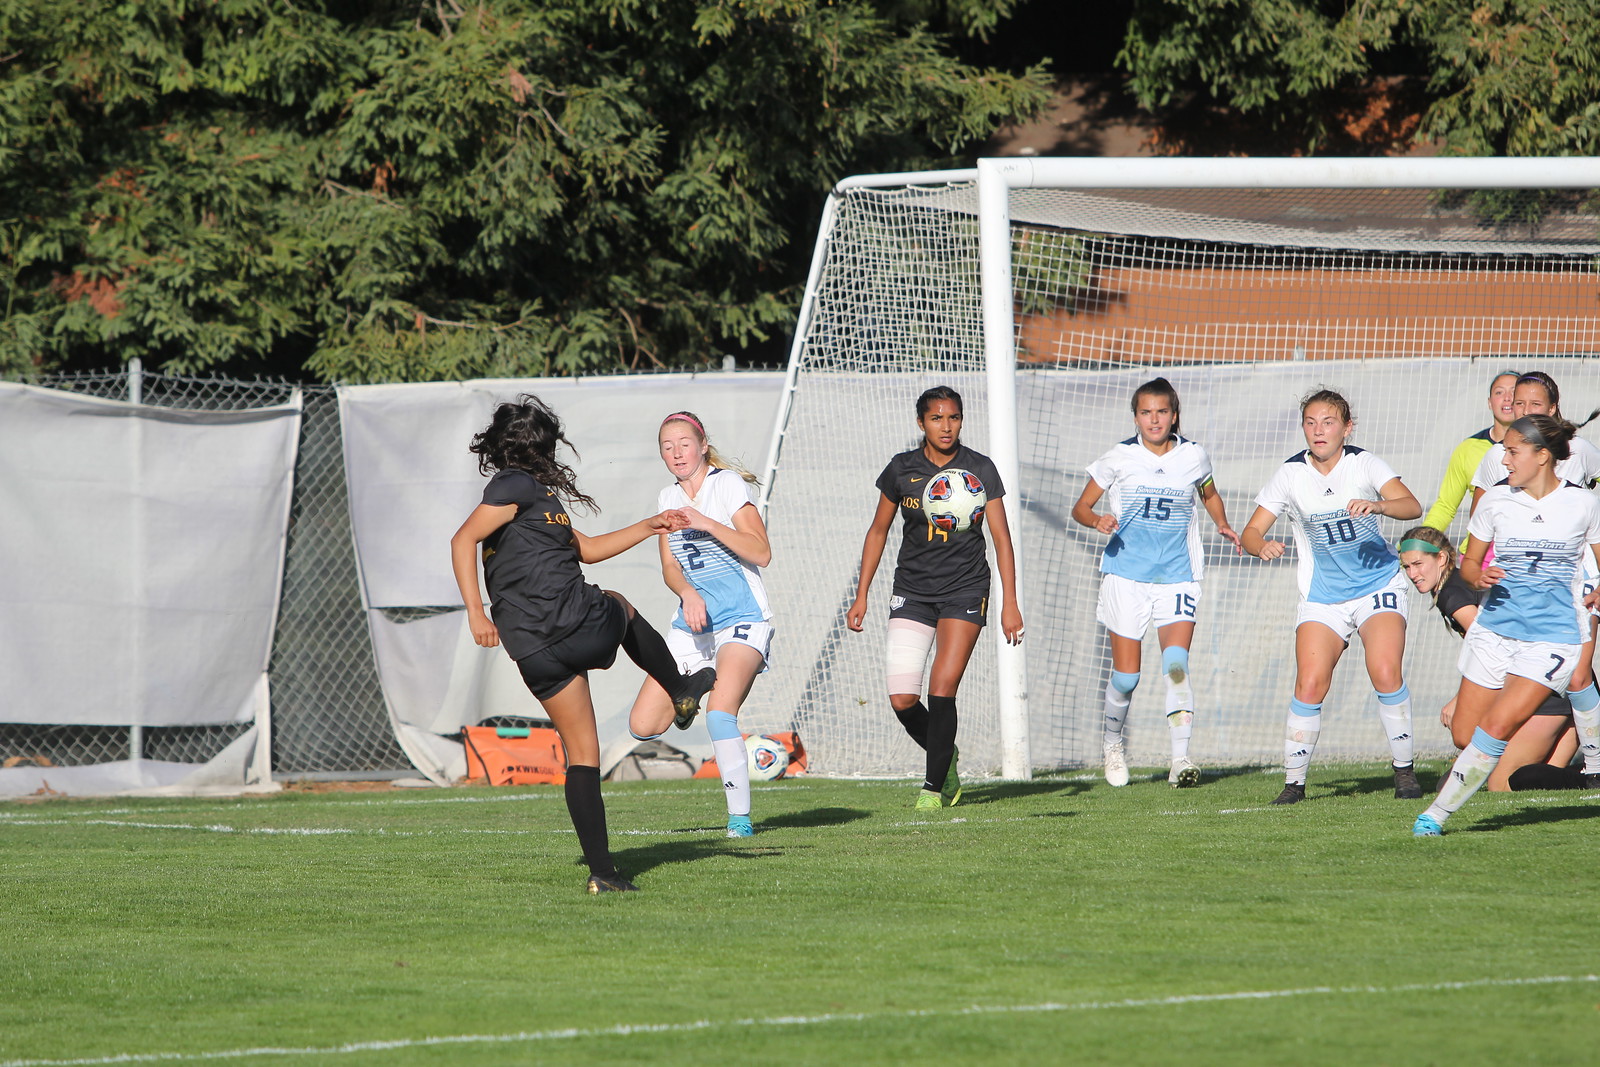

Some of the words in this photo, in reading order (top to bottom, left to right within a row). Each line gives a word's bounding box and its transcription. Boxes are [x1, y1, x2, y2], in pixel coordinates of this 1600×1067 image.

[1142, 497, 1174, 521] 15
[1336, 509, 1350, 518] STA
[1323, 519, 1357, 545] 10
[683, 543, 705, 570] 2
[1525, 551, 1544, 573] 7
[1174, 593, 1197, 617] 15
[1372, 592, 1398, 610] 10
[1544, 653, 1566, 681] 7
